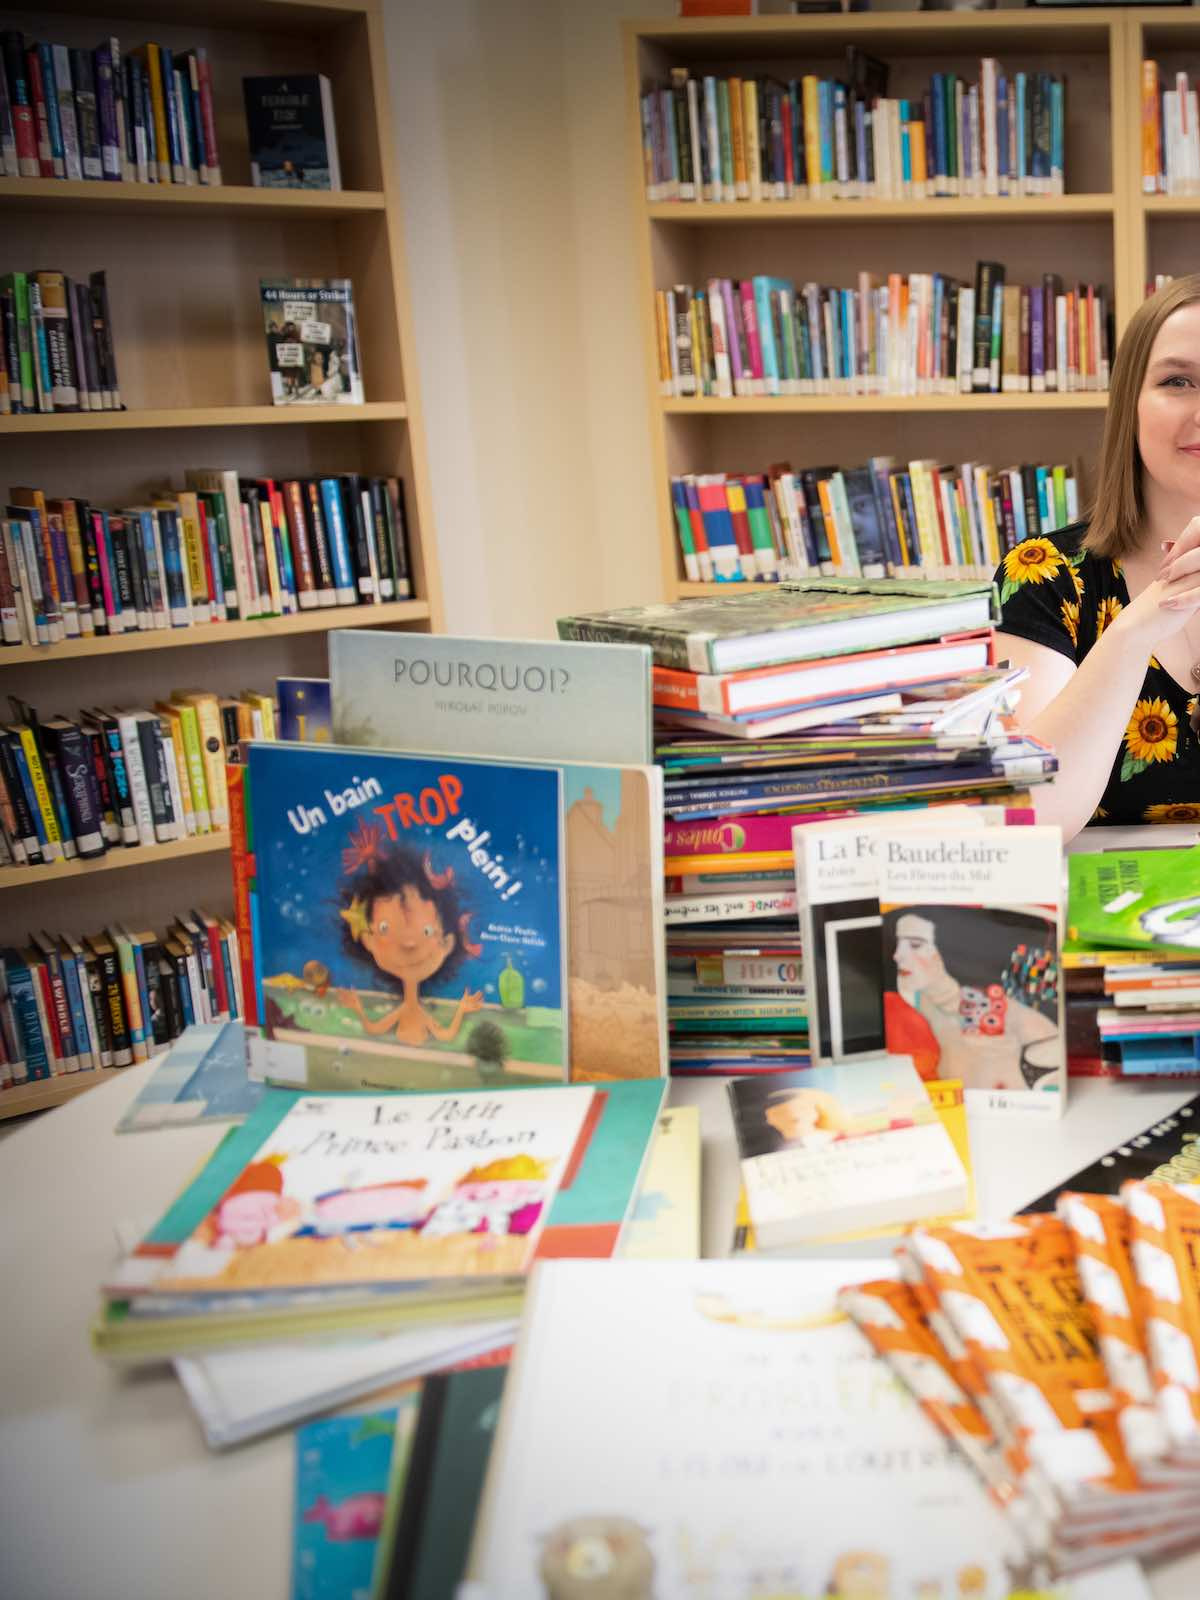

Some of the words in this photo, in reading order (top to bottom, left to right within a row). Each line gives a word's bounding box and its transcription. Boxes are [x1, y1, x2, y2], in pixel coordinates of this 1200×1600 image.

[393, 658, 570, 694] POURQUOI?
[287, 805, 328, 835] Un
[323, 775, 383, 817] bain
[374, 774, 463, 841] TROP
[817, 839, 849, 863] La
[887, 841, 1010, 865] Baudelaire
[371, 1103, 411, 1126] Le
[427, 1098, 505, 1123] Petit
[299, 1130, 409, 1157] Prince
[988, 1280, 1043, 1315] LE
